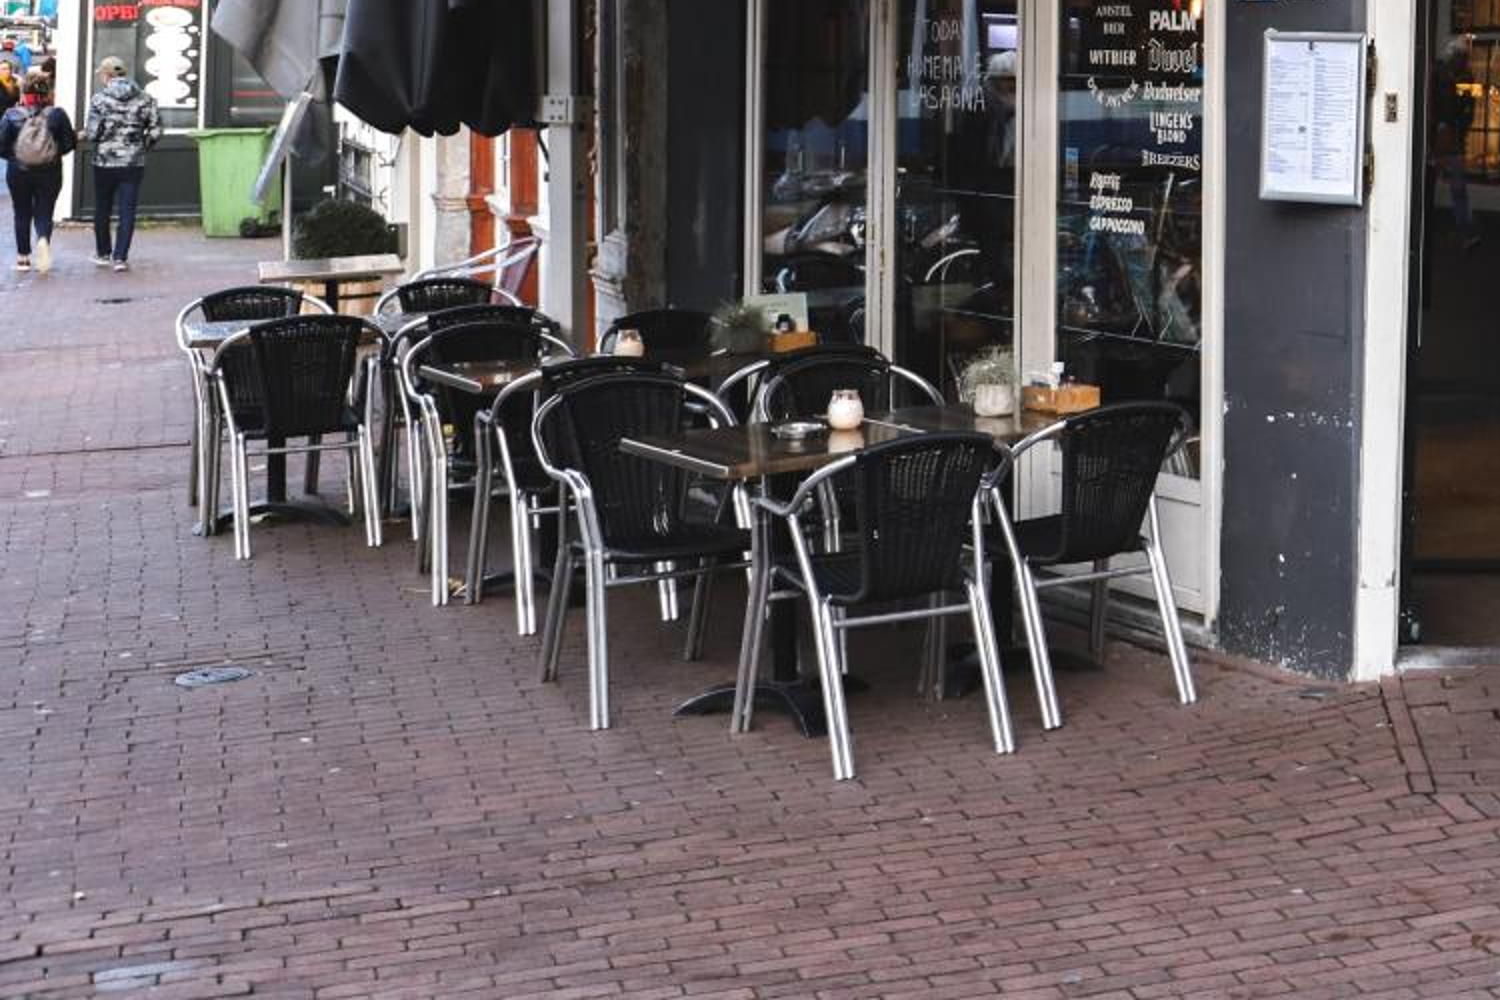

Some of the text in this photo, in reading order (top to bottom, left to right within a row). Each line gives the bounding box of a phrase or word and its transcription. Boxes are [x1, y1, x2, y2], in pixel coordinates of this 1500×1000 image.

[913, 18, 970, 43] TODA
[1149, 10, 1197, 31] PALM
[907, 52, 981, 81] HMEMAE
[1089, 49, 1137, 65] WITBIER
